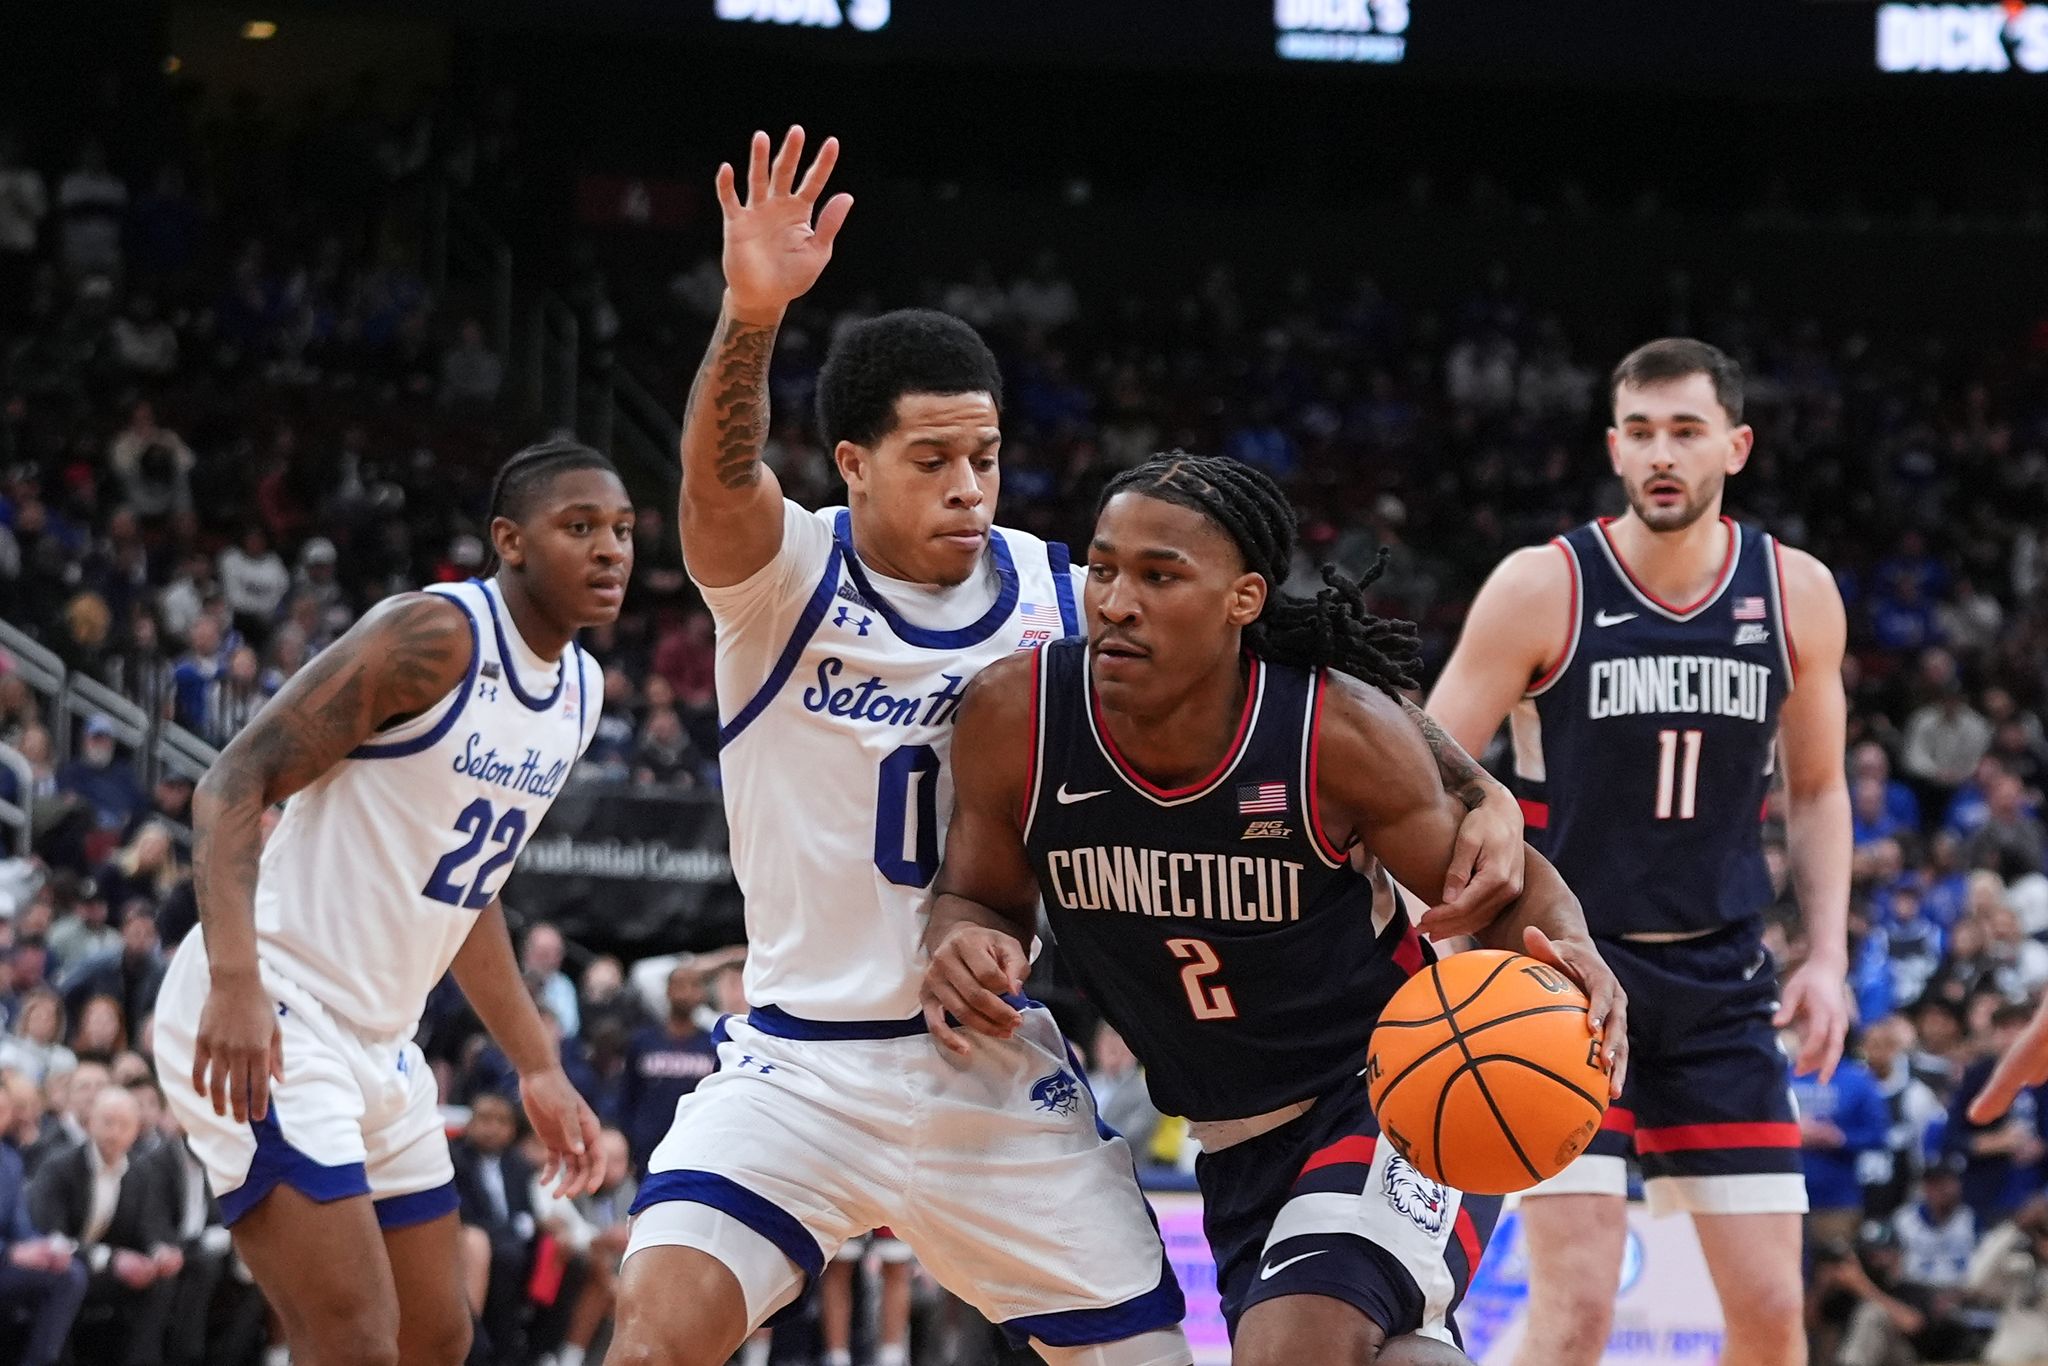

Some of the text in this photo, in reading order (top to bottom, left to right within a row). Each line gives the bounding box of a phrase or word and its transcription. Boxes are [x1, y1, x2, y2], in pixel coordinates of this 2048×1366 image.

[1023, 630, 1051, 640] BIG
[803, 657, 922, 726] Seton
[1589, 655, 1772, 723] CONNECTICUT
[453, 732, 568, 798] Seton Hall
[1656, 729, 1703, 820] 11
[874, 744, 941, 889] 0
[1243, 828, 1293, 836] EAST
[1249, 820, 1285, 829] BIG
[421, 797, 527, 910] 22
[516, 832, 646, 878] rudential
[1047, 846, 1304, 922] CONNECTICUT
[1164, 938, 1240, 1021] 2
